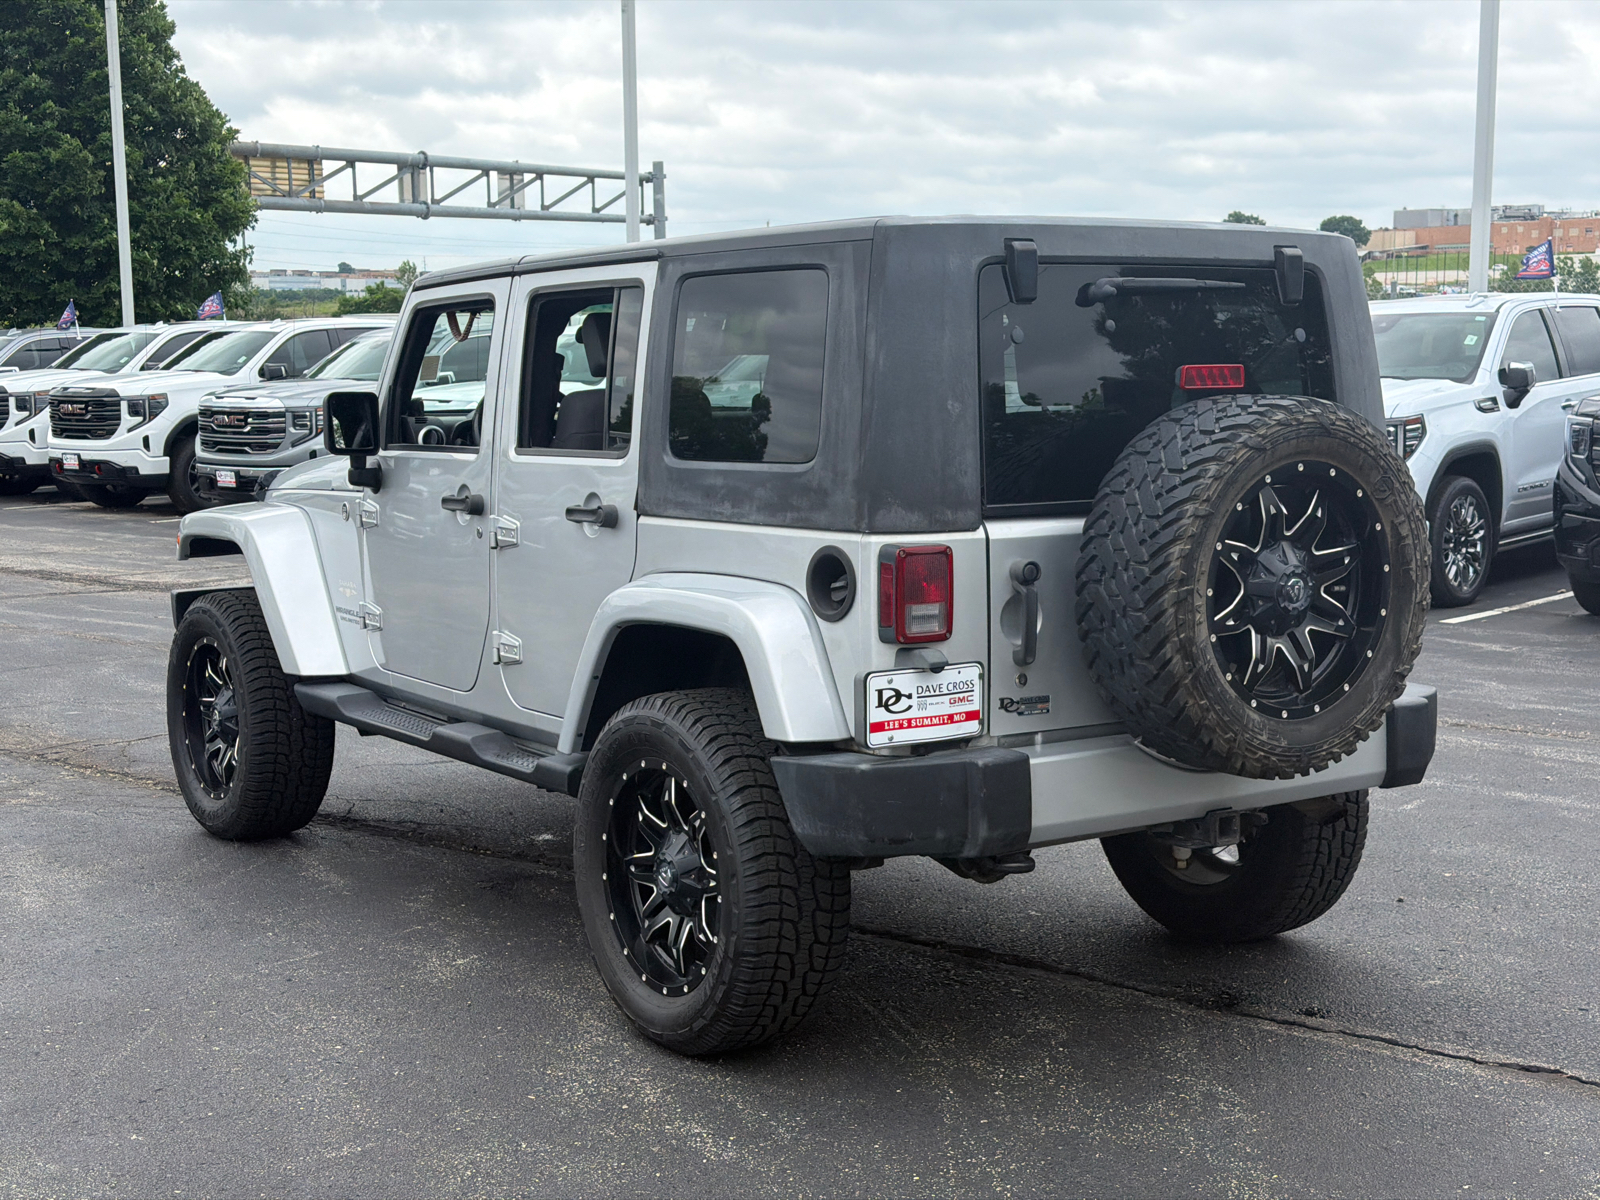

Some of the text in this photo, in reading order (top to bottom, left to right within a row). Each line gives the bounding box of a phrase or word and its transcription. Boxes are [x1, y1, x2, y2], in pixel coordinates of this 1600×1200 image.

[59, 403, 86, 414] GMC
[212, 414, 245, 426] GMC
[335, 605, 360, 618] WRANGLE
[916, 679, 975, 695] DAVE CROSS
[875, 687, 913, 714] DC
[949, 694, 974, 705] GMC
[884, 713, 966, 730] LEE'S SUMMIT, MO
